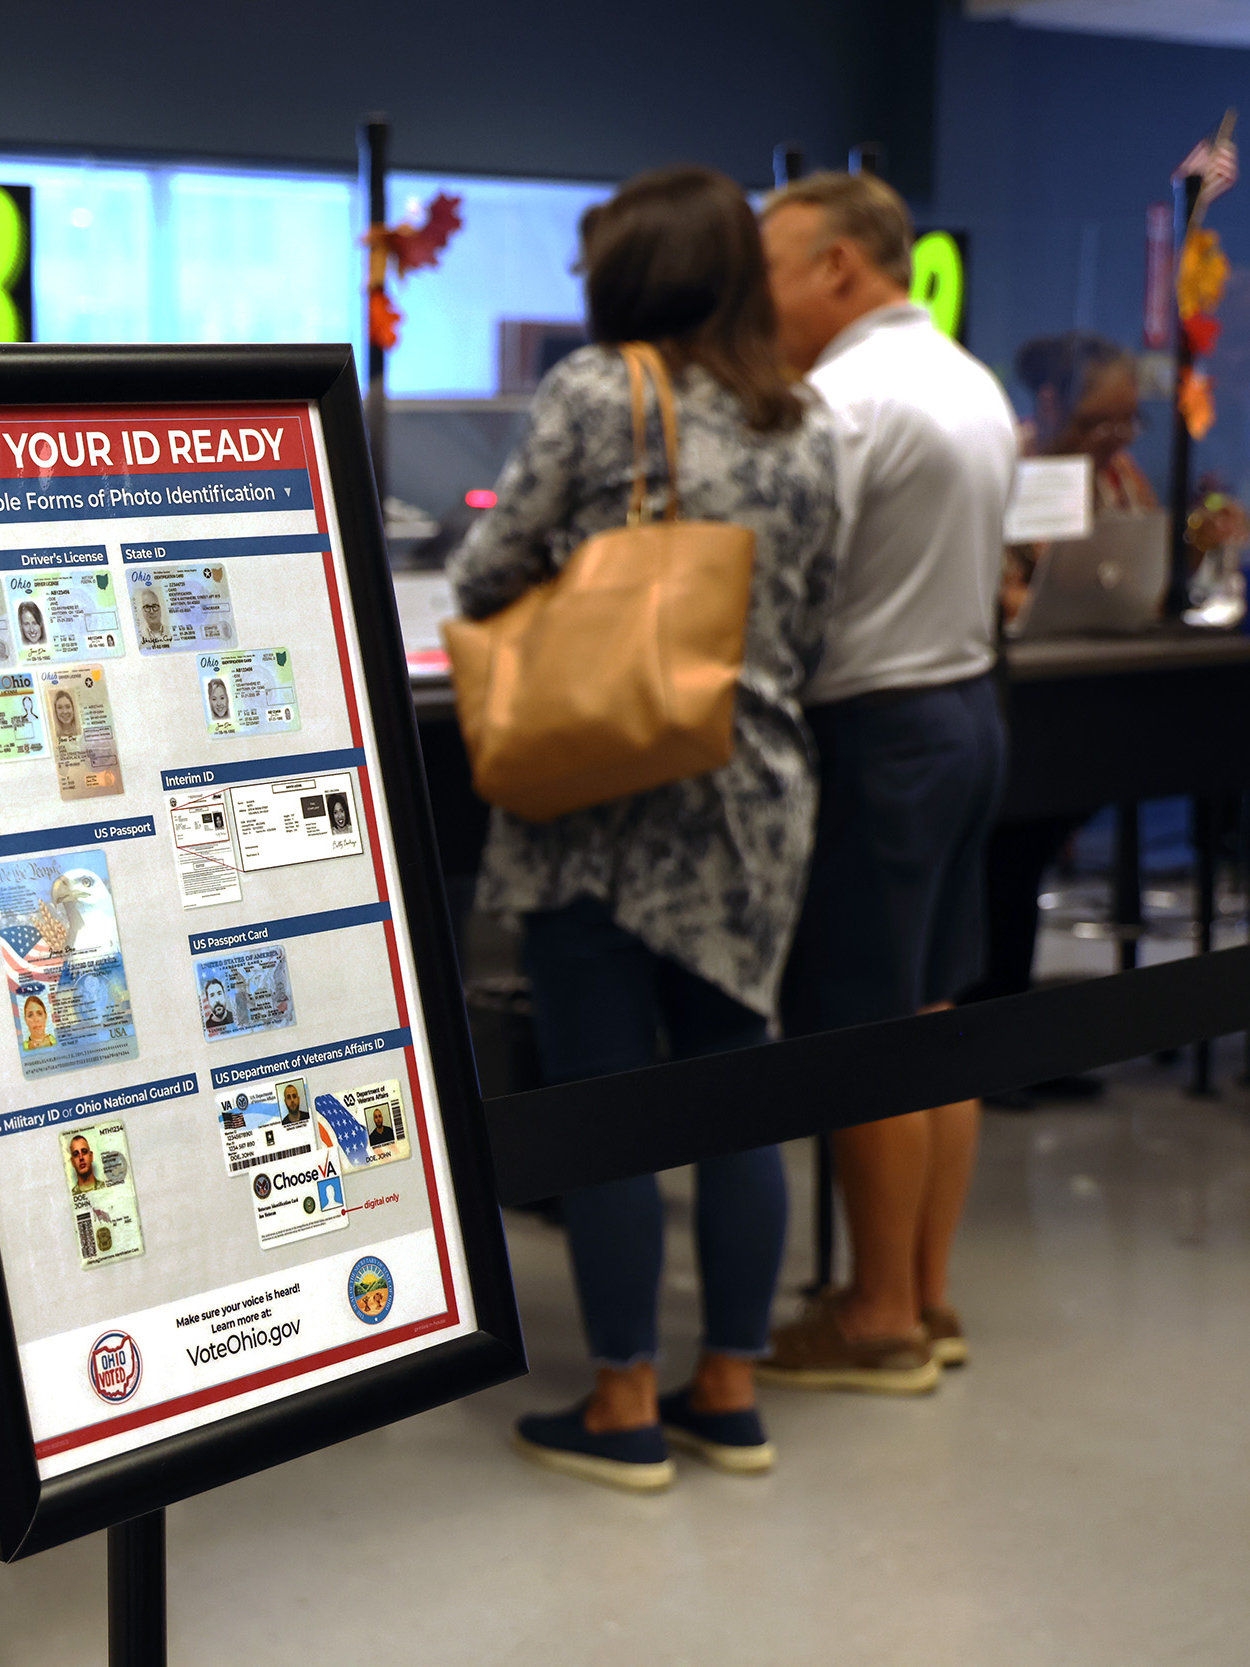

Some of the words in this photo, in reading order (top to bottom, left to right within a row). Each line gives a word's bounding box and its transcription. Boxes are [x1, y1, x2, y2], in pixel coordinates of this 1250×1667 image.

[2, 431, 114, 468] YOUR
[121, 430, 161, 466] ID
[167, 427, 284, 464] READY
[25, 492, 84, 511] Forms
[87, 489, 106, 508] of
[110, 488, 162, 507] Photo
[165, 482, 275, 504] Identification
[21, 552, 63, 566] Driver's
[63, 551, 104, 563] License
[125, 549, 153, 560] State
[154, 547, 166, 558] ID
[10, 578, 31, 590] Ohio
[131, 571, 151, 582] Ohio
[200, 657, 219, 668] Ohio
[1, 675, 31, 689] Ohio
[165, 772, 201, 787] Interim
[202, 770, 215, 783] ID
[94, 828, 109, 839] US
[110, 822, 152, 837] Passport
[193, 938, 207, 950] US
[207, 933, 247, 947] Passport
[247, 928, 269, 941] Card
[223, 957, 245, 966] STATES
[109, 1028, 128, 1039] USA
[215, 1071, 229, 1084] US
[230, 1059, 290, 1081] Department
[291, 1056, 301, 1069] of
[301, 1046, 343, 1065] Veterans
[344, 1040, 374, 1056] Affairs
[375, 1037, 385, 1049] ID
[356, 1089, 380, 1098] Department
[357, 1096, 374, 1104] Veterans
[376, 1092, 389, 1100] Affairs
[3, 1113, 46, 1131] Military
[47, 1108, 60, 1122] ID
[62, 1107, 73, 1118] or
[75, 1099, 102, 1115] Ohio
[103, 1088, 148, 1109] National
[149, 1081, 181, 1099] Guard
[182, 1079, 194, 1092] ID
[221, 1100, 232, 1111] VA
[378, 1151, 391, 1160] JOHN
[364, 1196, 385, 1210] digital
[385, 1193, 400, 1203] only
[176, 1314, 200, 1328] Make
[201, 1308, 220, 1321] sure
[221, 1302, 241, 1317] your
[242, 1295, 265, 1308] voice
[265, 1291, 273, 1302] is
[274, 1283, 301, 1299] heard!
[211, 1320, 236, 1334] Learn
[237, 1312, 260, 1326] more
[261, 1308, 272, 1319] at:
[186, 1319, 301, 1366] VoteOhio.gov
[101, 1350, 126, 1370] OHIO
[98, 1366, 126, 1388] VOTED
